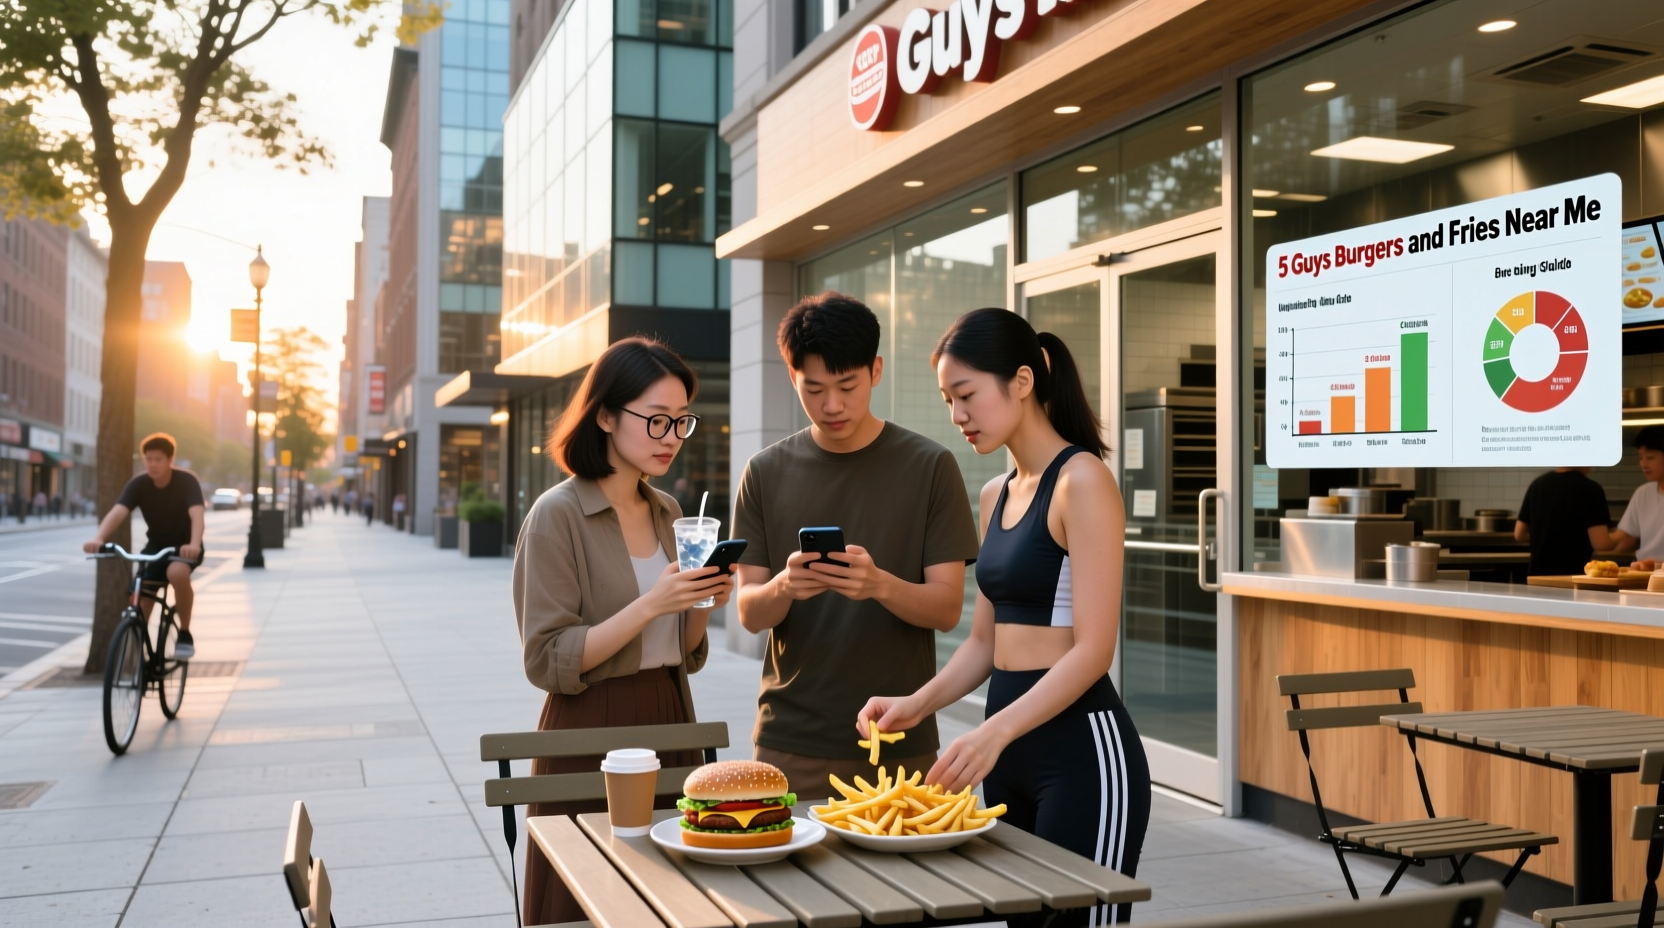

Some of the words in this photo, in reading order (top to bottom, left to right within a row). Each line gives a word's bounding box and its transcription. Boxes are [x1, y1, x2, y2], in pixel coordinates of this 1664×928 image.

[896, 0, 1025, 94] Guys
[1278, 255, 1288, 278] 5
[1291, 252, 1331, 278] Guys
[1334, 237, 1404, 268] Burgers
[1408, 223, 1443, 254] and
[1449, 215, 1500, 246] Fries
[1505, 207, 1559, 237] Near
[1564, 195, 1601, 226] Me
